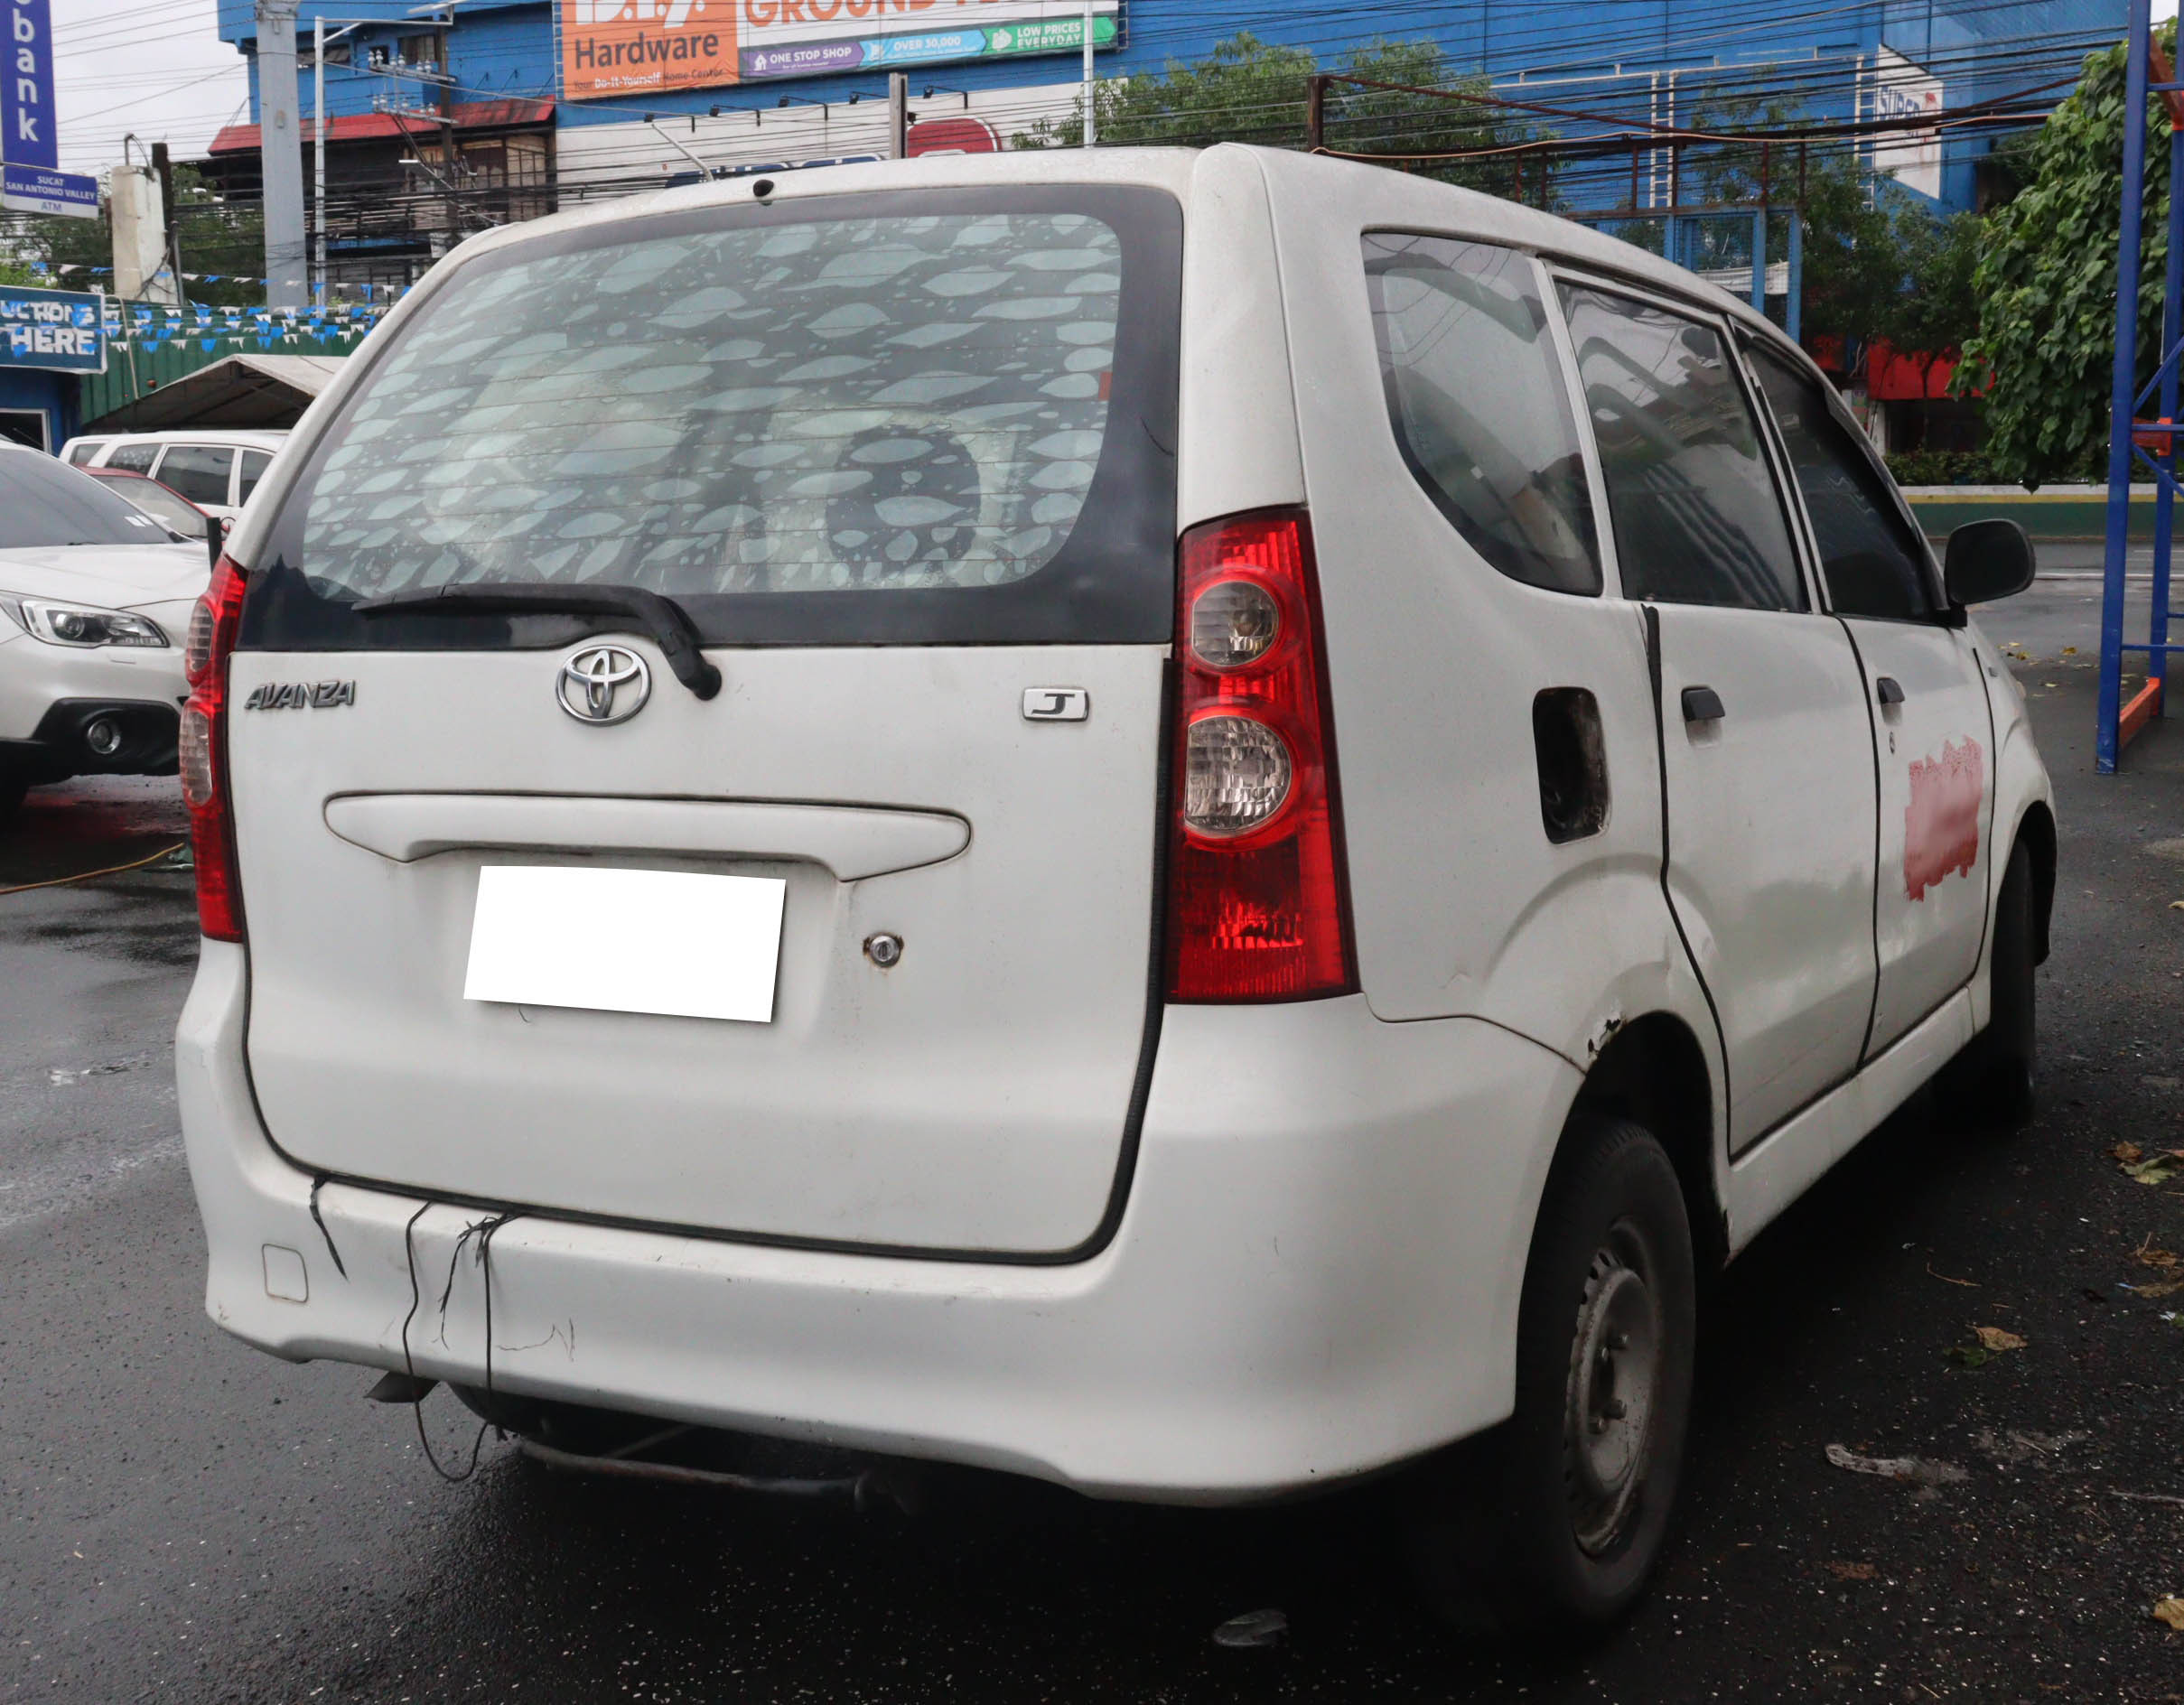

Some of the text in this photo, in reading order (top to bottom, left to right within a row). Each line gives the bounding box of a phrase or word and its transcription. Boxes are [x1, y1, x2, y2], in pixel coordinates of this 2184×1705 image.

[1017, 22, 1081, 38] LOW PRICES
[893, 39, 924, 52] OVER
[1017, 33, 1082, 50] EVERYDAY
[574, 32, 720, 70] Hardware
[770, 46, 853, 65] ONE STOP SHOP
[13, 0, 39, 143] bank
[37, 175, 65, 187] SUCAT
[5, 182, 96, 200] SAN ANTONIO VALLEY
[41, 201, 63, 213] ATM
[11, 326, 96, 356] HERE
[244, 679, 356, 710] AVANZA
[1031, 693, 1076, 715] J
